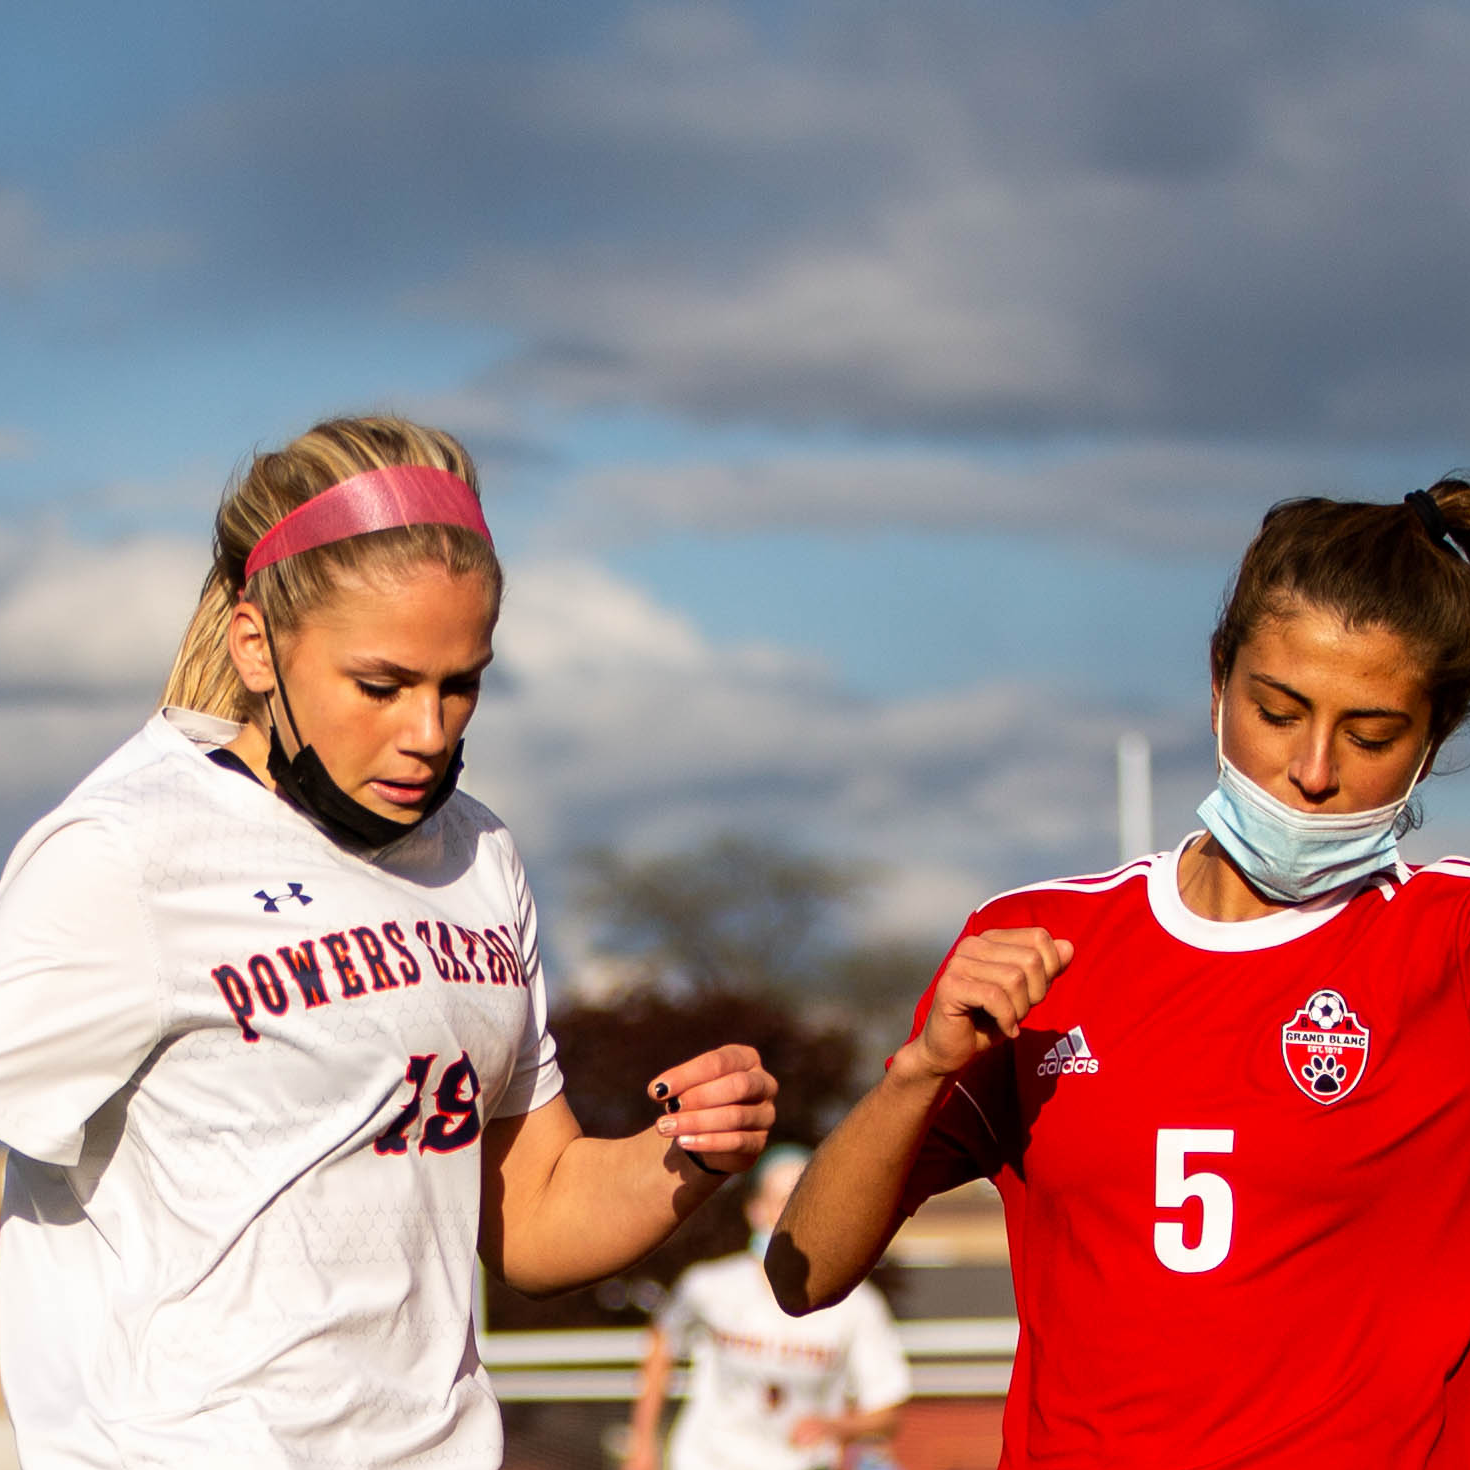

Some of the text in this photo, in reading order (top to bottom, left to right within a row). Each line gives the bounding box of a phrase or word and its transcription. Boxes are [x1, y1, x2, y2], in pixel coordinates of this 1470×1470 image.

[211, 921, 422, 1043] POWERS
[1037, 1055, 1099, 1077] adidas
[1286, 1032, 1365, 1046] GRAND BLANC
[373, 1049, 481, 1157] 19
[1153, 1128, 1235, 1274] 5
